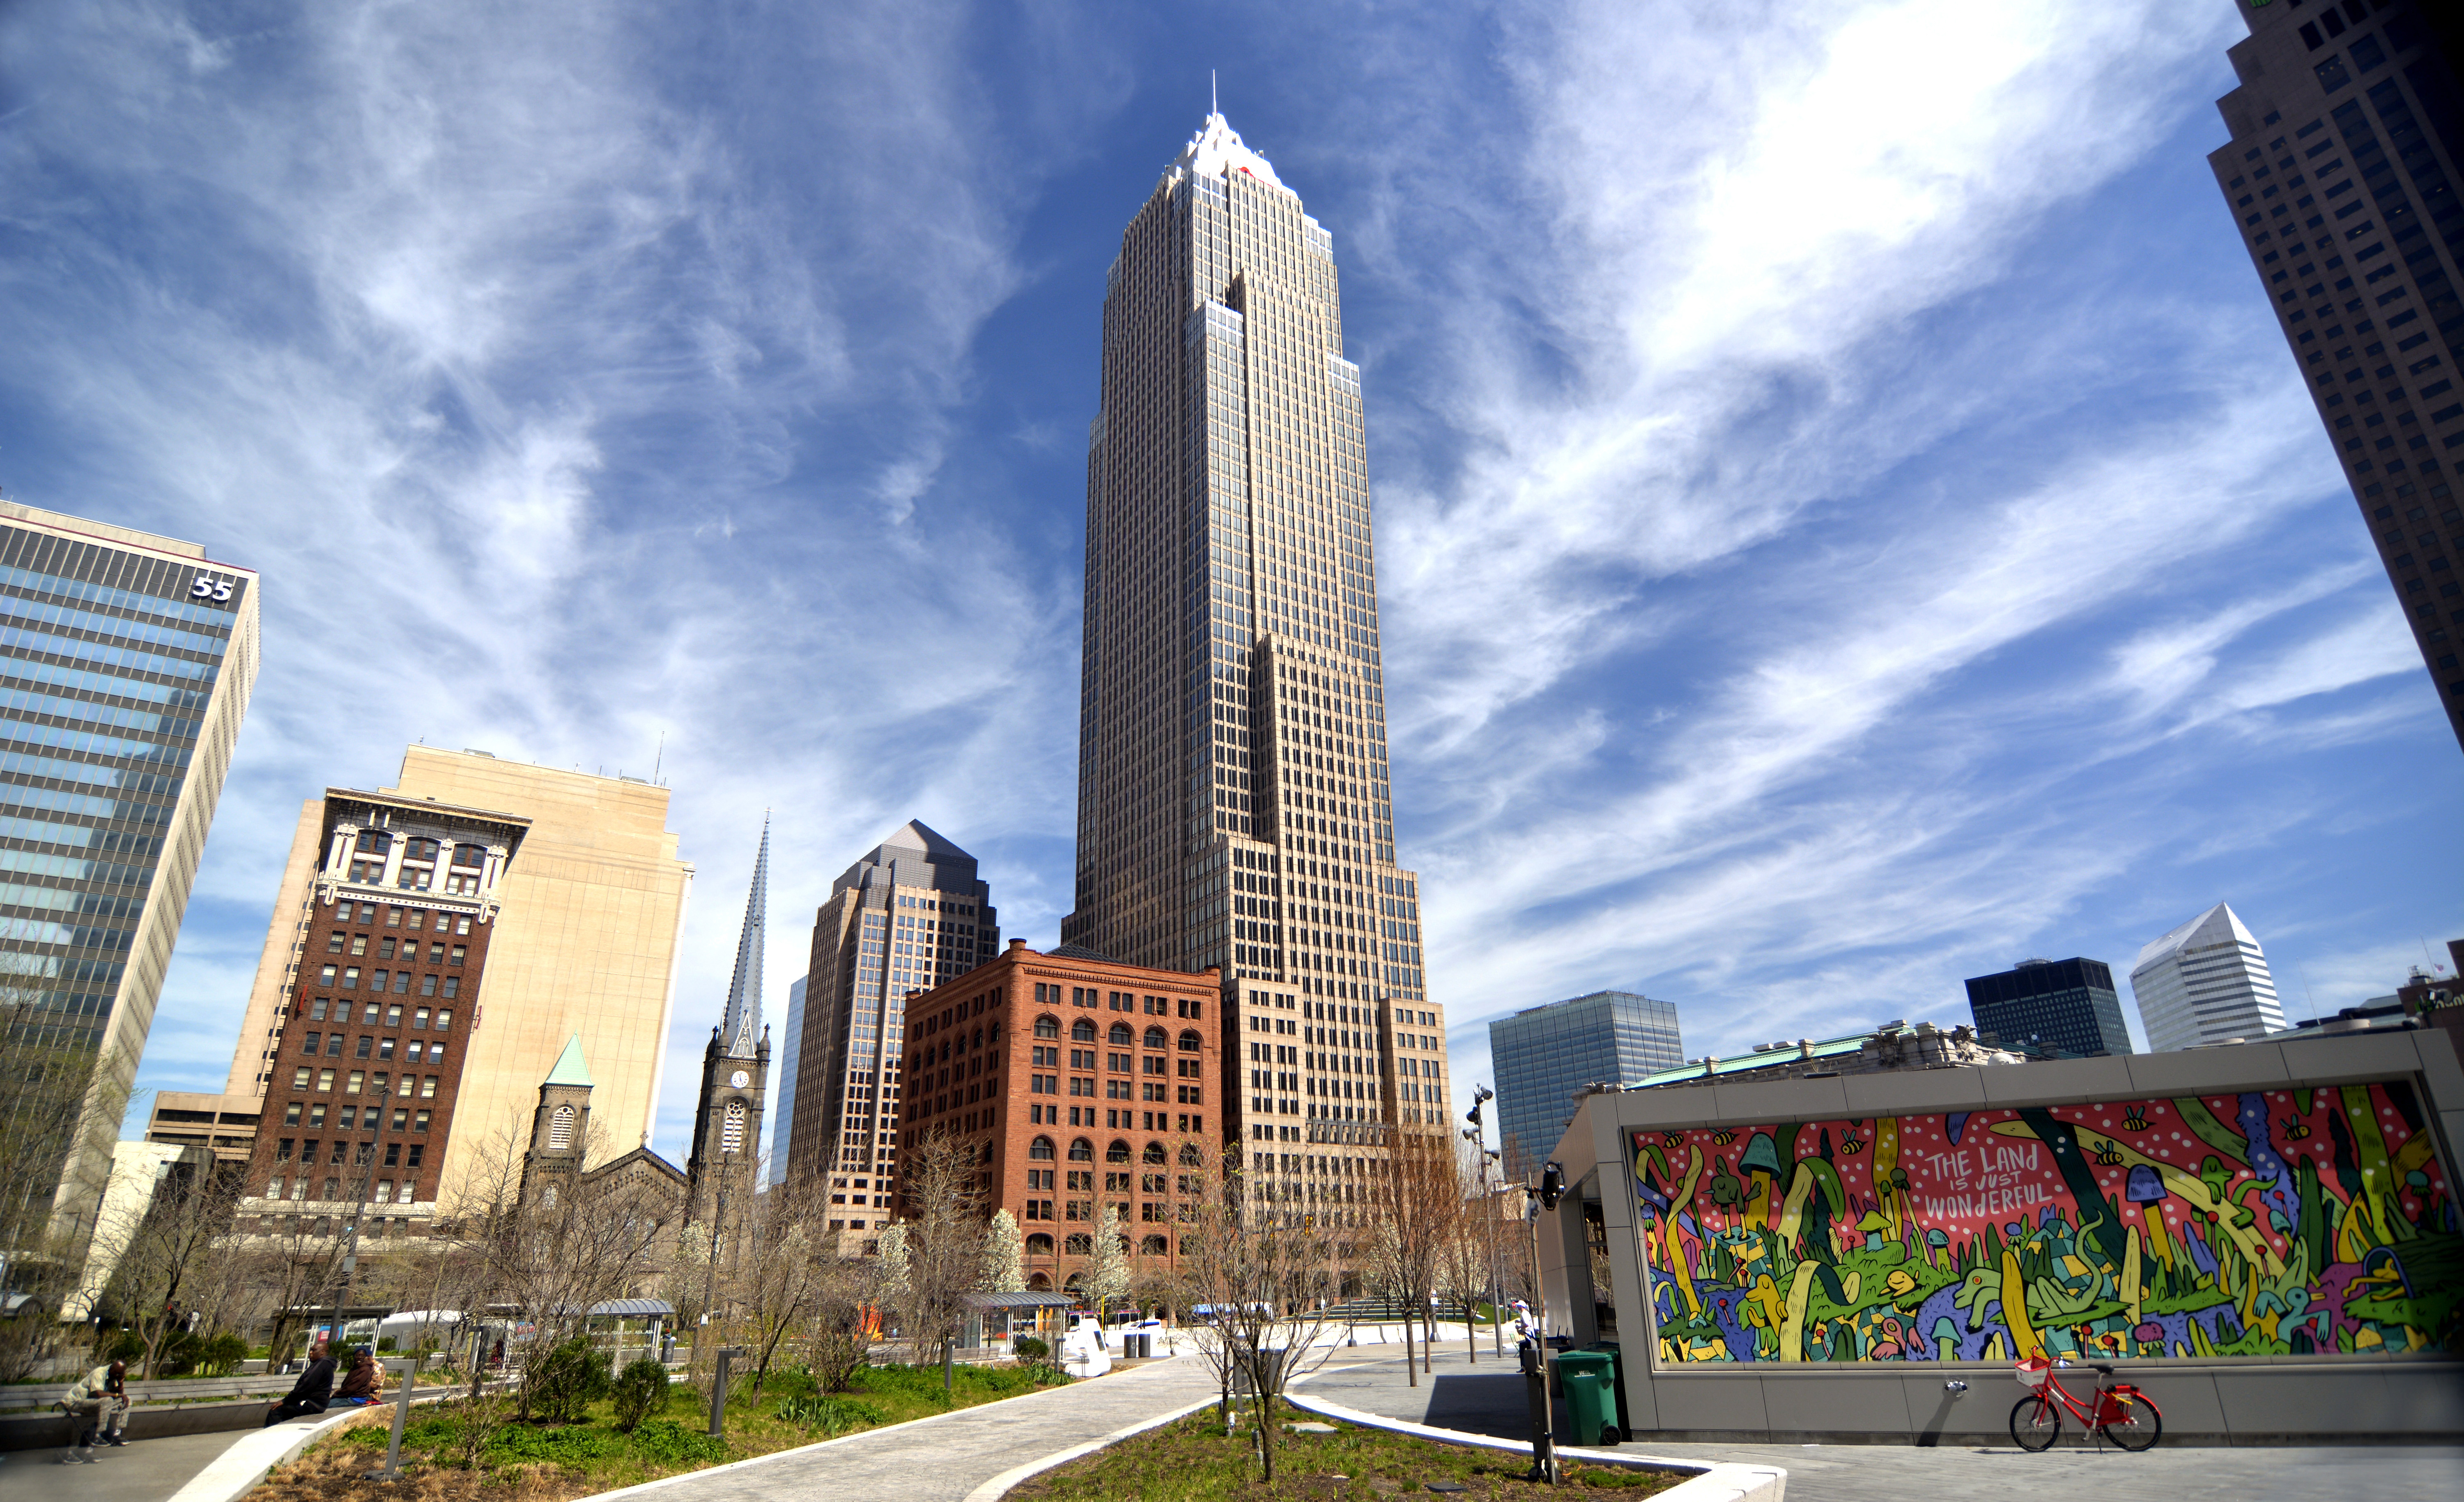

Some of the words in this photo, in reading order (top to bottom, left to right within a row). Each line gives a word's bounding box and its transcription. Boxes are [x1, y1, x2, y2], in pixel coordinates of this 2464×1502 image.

[193, 577, 232, 600] 55
[1924, 1150, 1972, 1182] THE
[1950, 1178, 1968, 1191] IS
[1975, 1171, 2021, 1190] JUST
